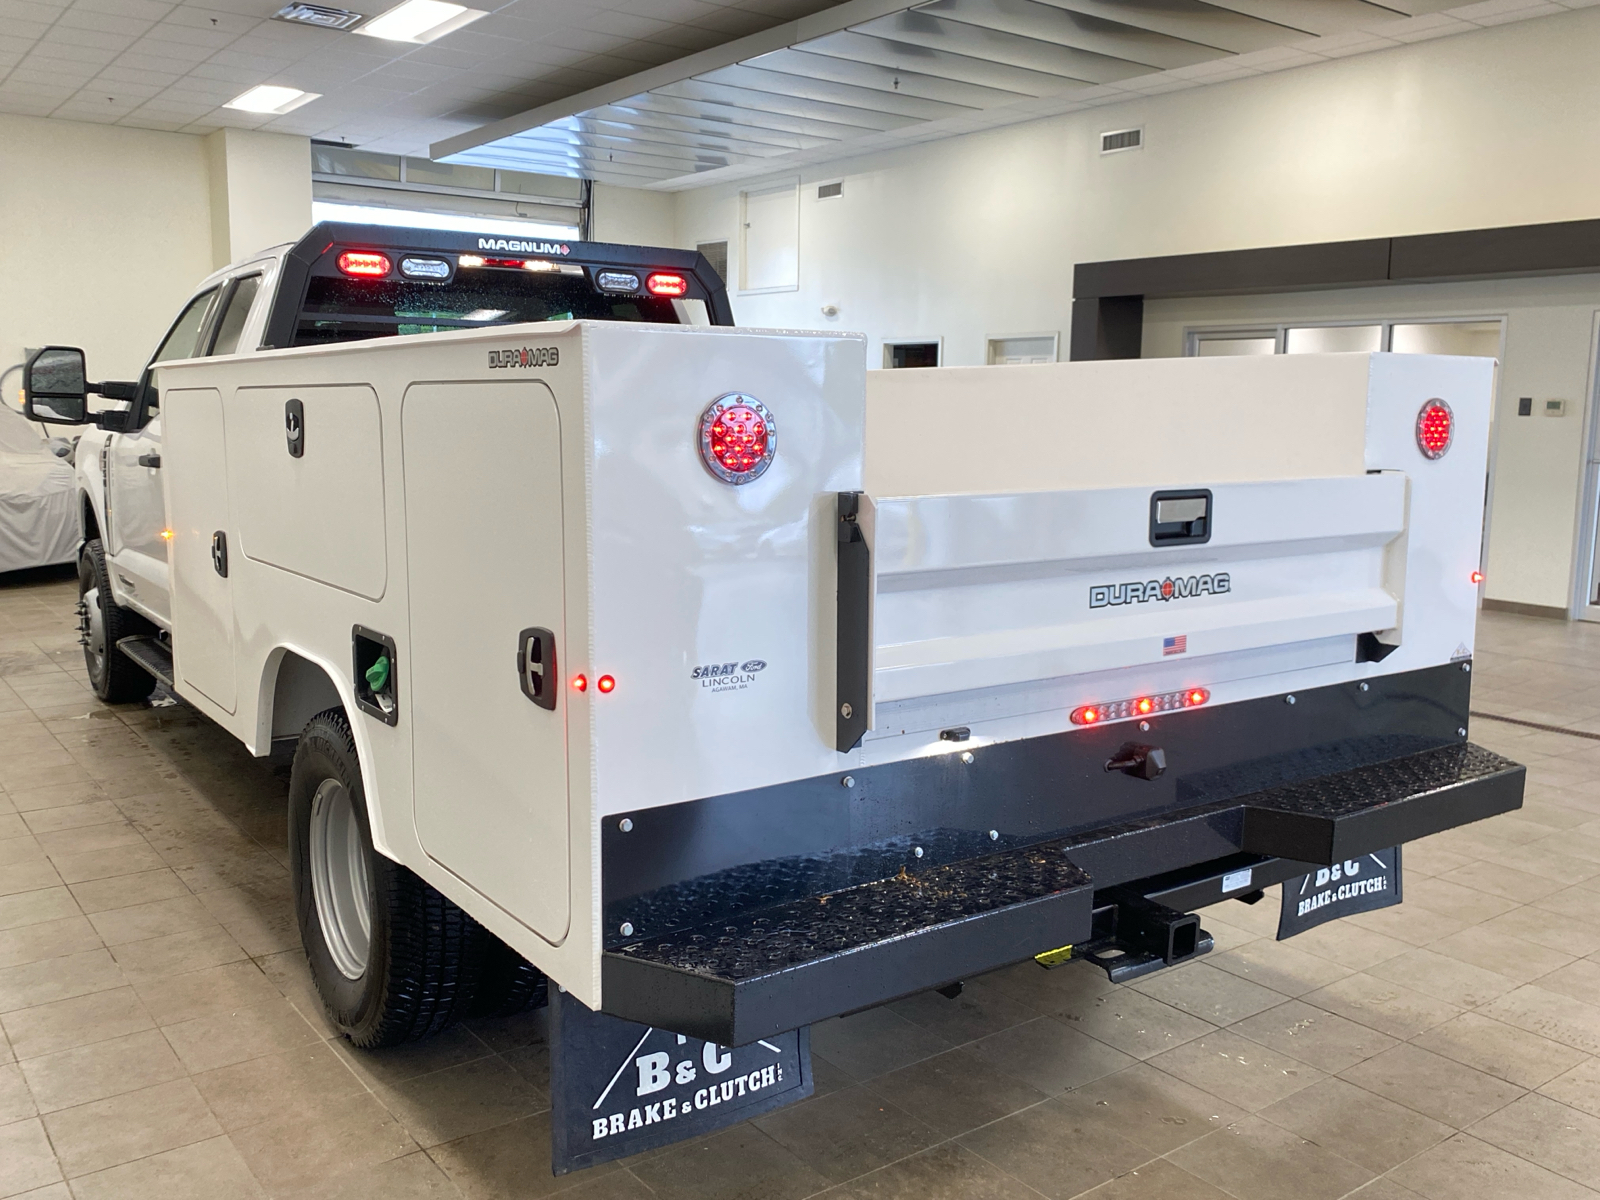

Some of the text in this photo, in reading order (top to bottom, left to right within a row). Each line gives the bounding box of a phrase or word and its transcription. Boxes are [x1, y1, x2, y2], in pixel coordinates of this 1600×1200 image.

[478, 238, 561, 255] MAGNUM
[690, 660, 765, 679] SARAT Ford
[702, 674, 755, 687] LINCOLN
[711, 685, 738, 693] AGAWAM,
[1297, 889, 1332, 917] BRAKE
[1338, 876, 1383, 901] CLUTCH
[592, 1097, 677, 1140] BRAKE
[694, 1065, 776, 1110] CLUTCH
